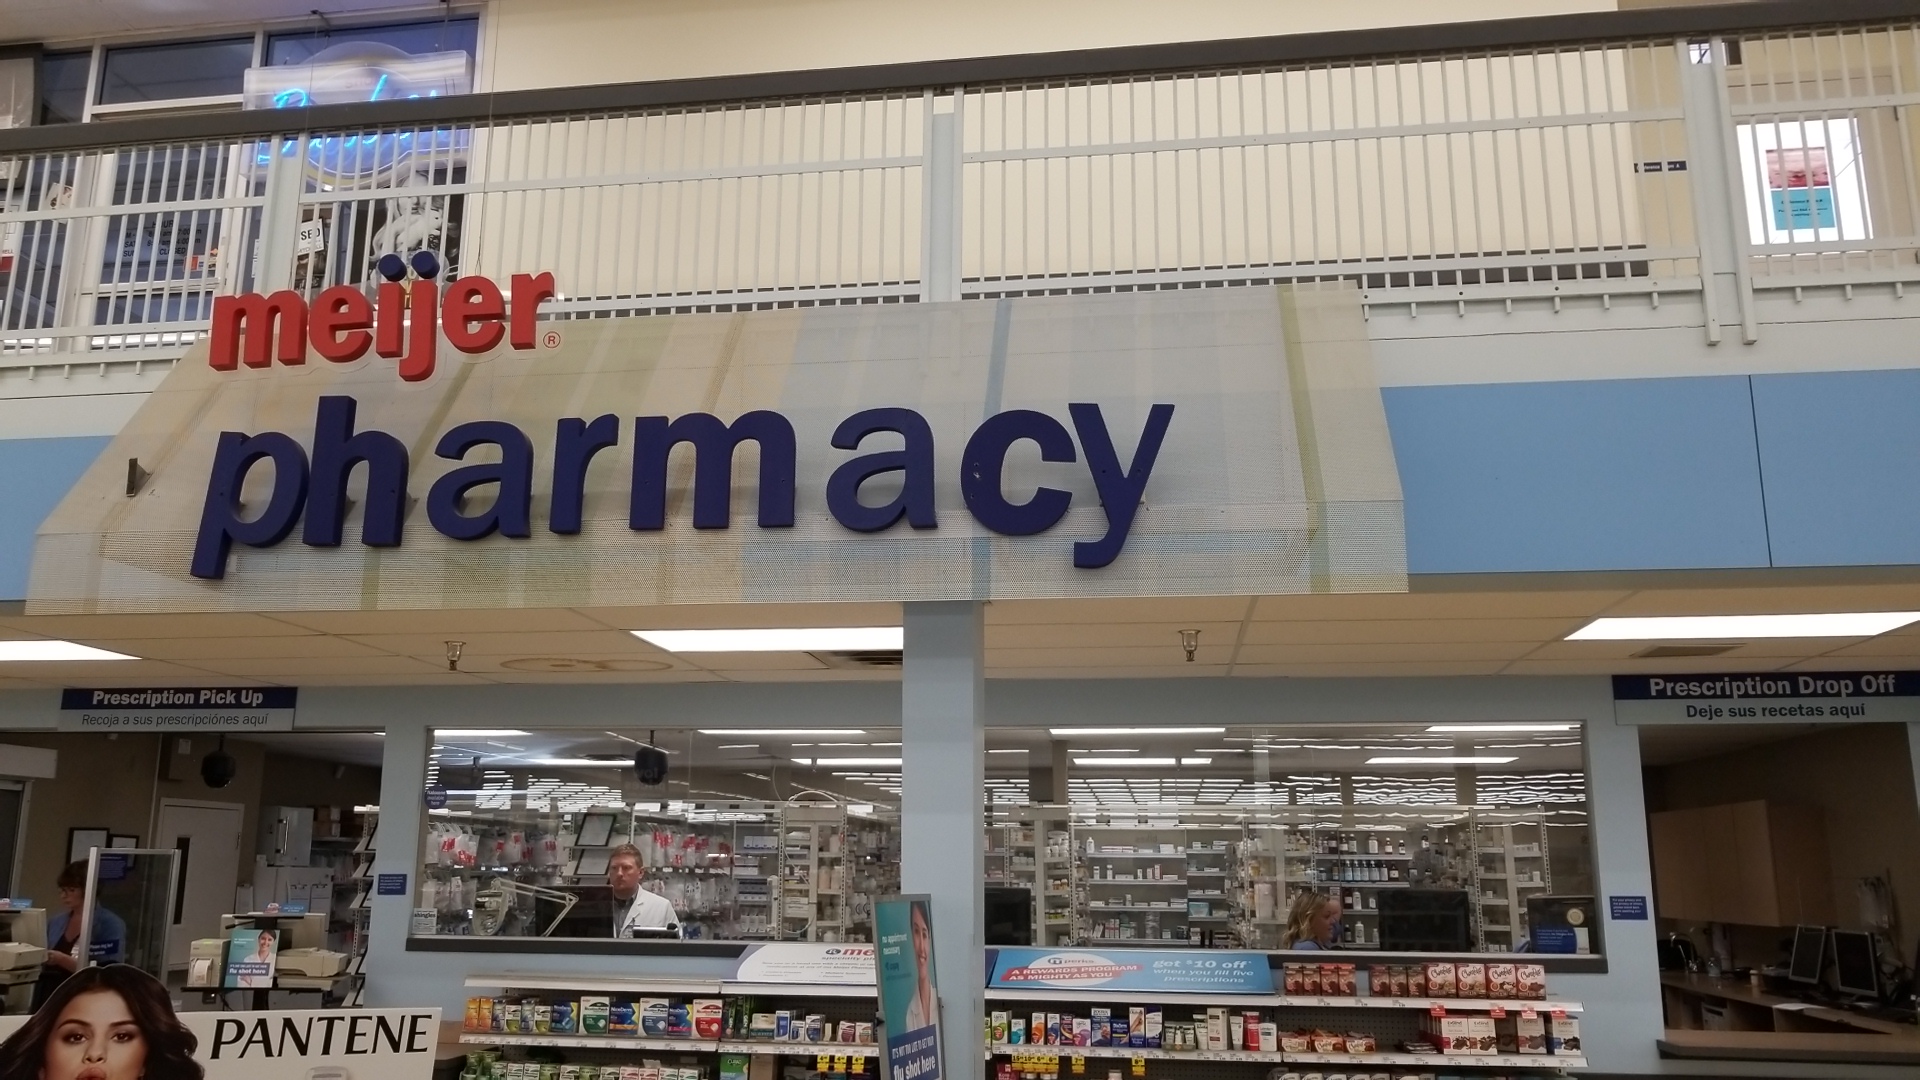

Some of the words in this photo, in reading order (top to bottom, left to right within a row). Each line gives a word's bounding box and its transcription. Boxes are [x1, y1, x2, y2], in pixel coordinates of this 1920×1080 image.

[209, 251, 555, 382] meijer
[189, 396, 1175, 579] pharmacy
[1650, 676, 1792, 698] Prescription
[1798, 676, 1854, 698] Drop
[1860, 674, 1896, 694] Off
[92, 690, 195, 707] Prescription
[199, 690, 238, 704] Pick
[240, 690, 264, 706] Up
[82, 714, 120, 728] Recoja
[122, 716, 130, 724] a
[132, 716, 153, 724] sus
[156, 713, 240, 728] prescripciónes
[242, 712, 270, 727] aquí
[1686, 704, 1724, 720] Deje
[1728, 706, 1757, 718] sus
[1762, 704, 1825, 718] recetas
[1829, 703, 1866, 719] aquí
[1152, 959, 1181, 968] get
[1186, 960, 1217, 968] $10
[210, 1014, 432, 1060] PANTENE
[894, 1064, 904, 1080] flu
[905, 1057, 921, 1080] shot
[921, 1055, 936, 1074] here
